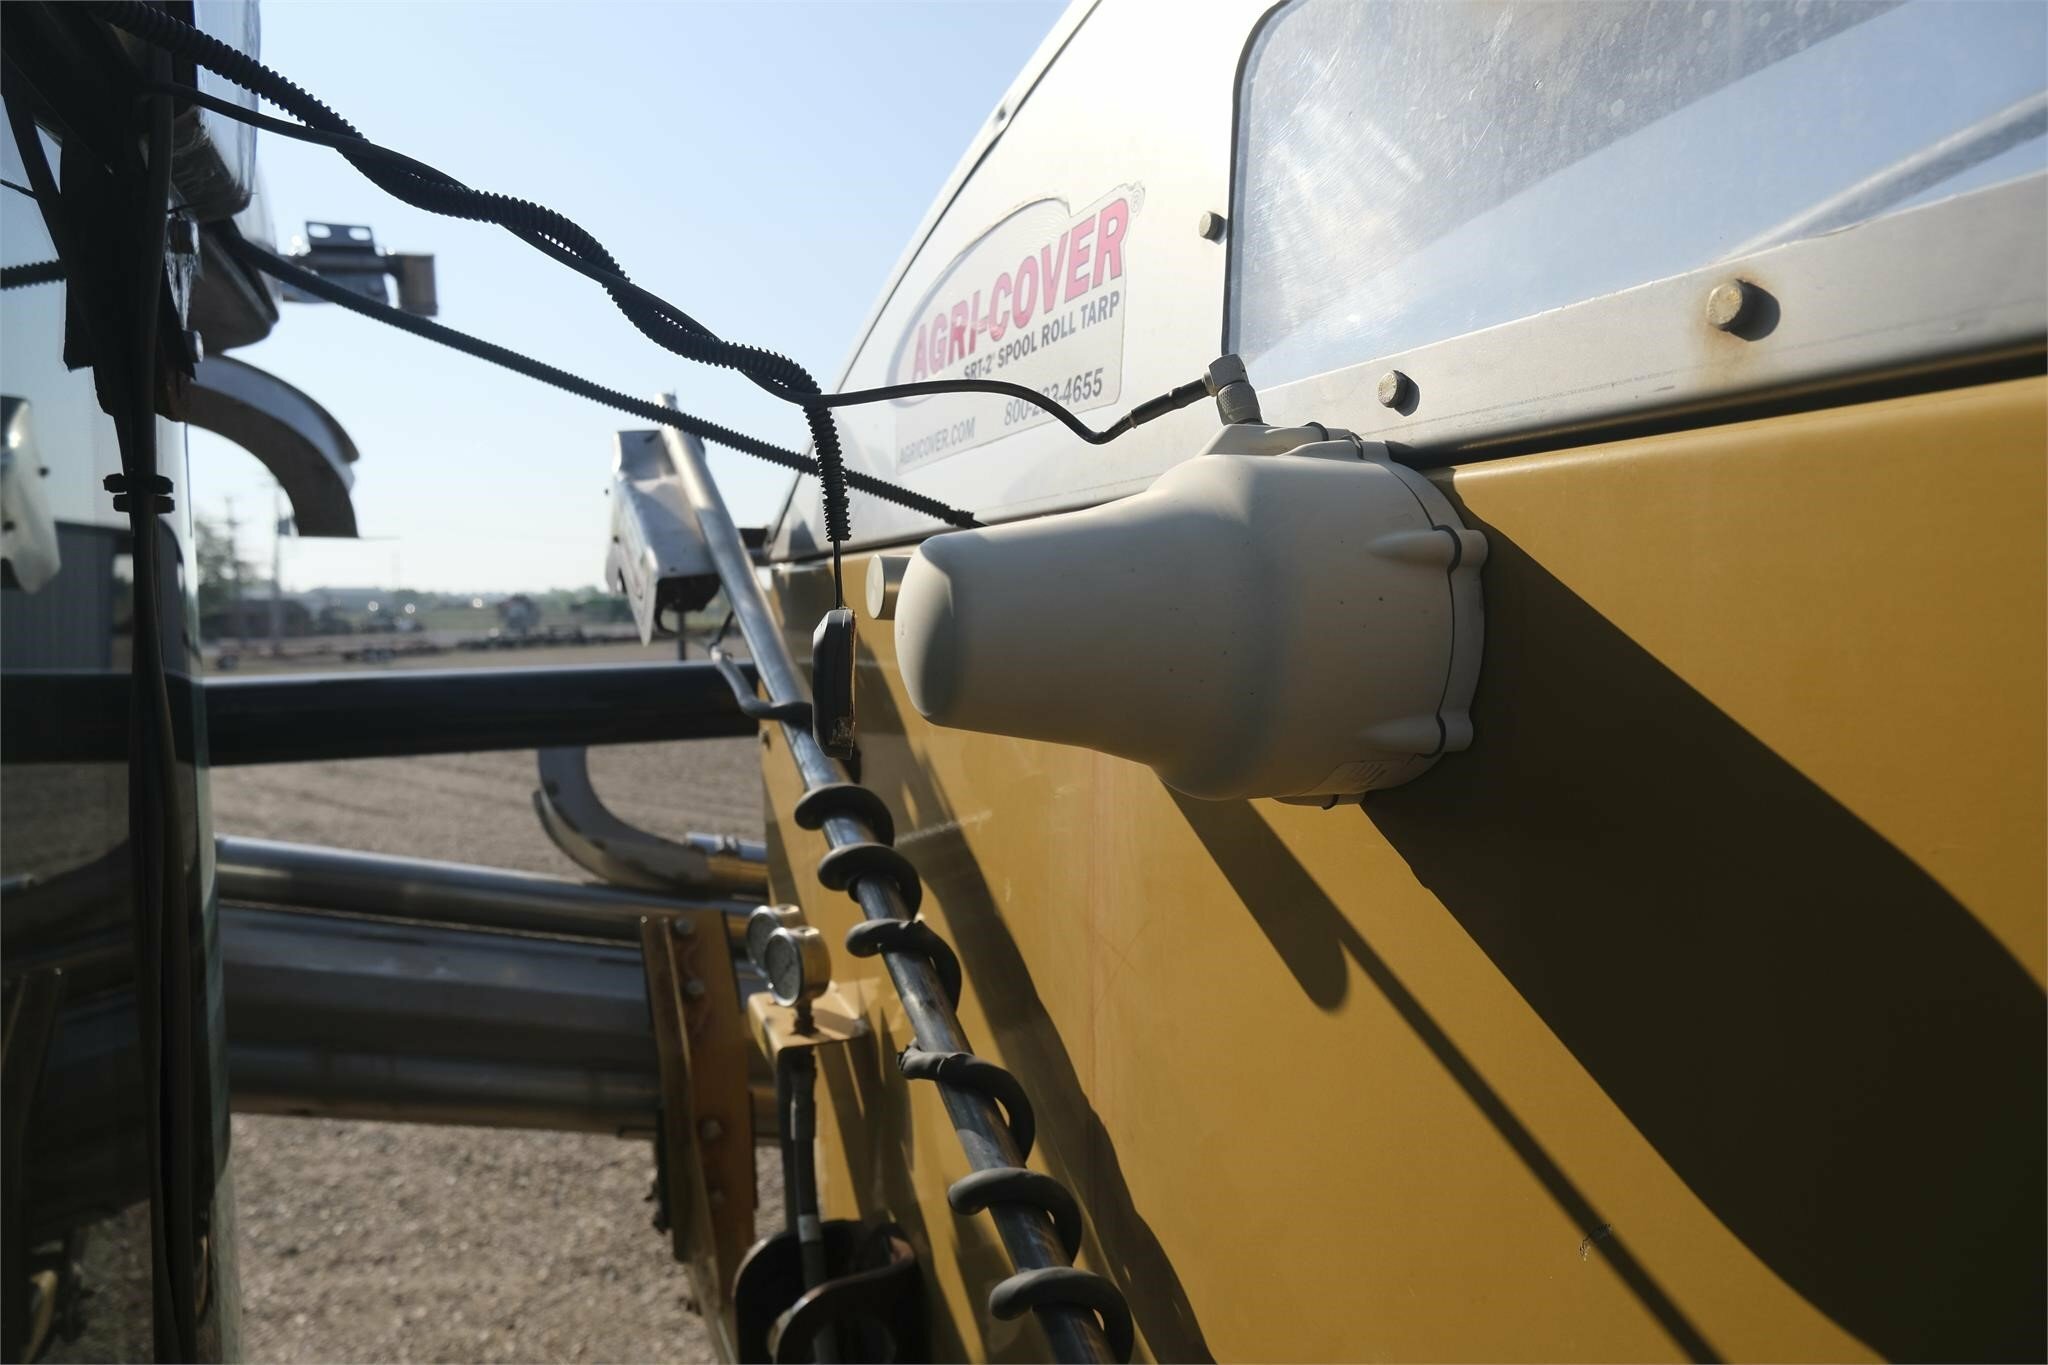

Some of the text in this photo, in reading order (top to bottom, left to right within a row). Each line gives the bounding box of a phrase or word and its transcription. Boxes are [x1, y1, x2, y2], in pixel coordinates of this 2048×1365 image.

[911, 198, 1129, 382] AGRI-COVER
[998, 330, 1037, 368] SPOOL
[1041, 314, 1076, 347] ROLL
[1081, 290, 1120, 331] TARP
